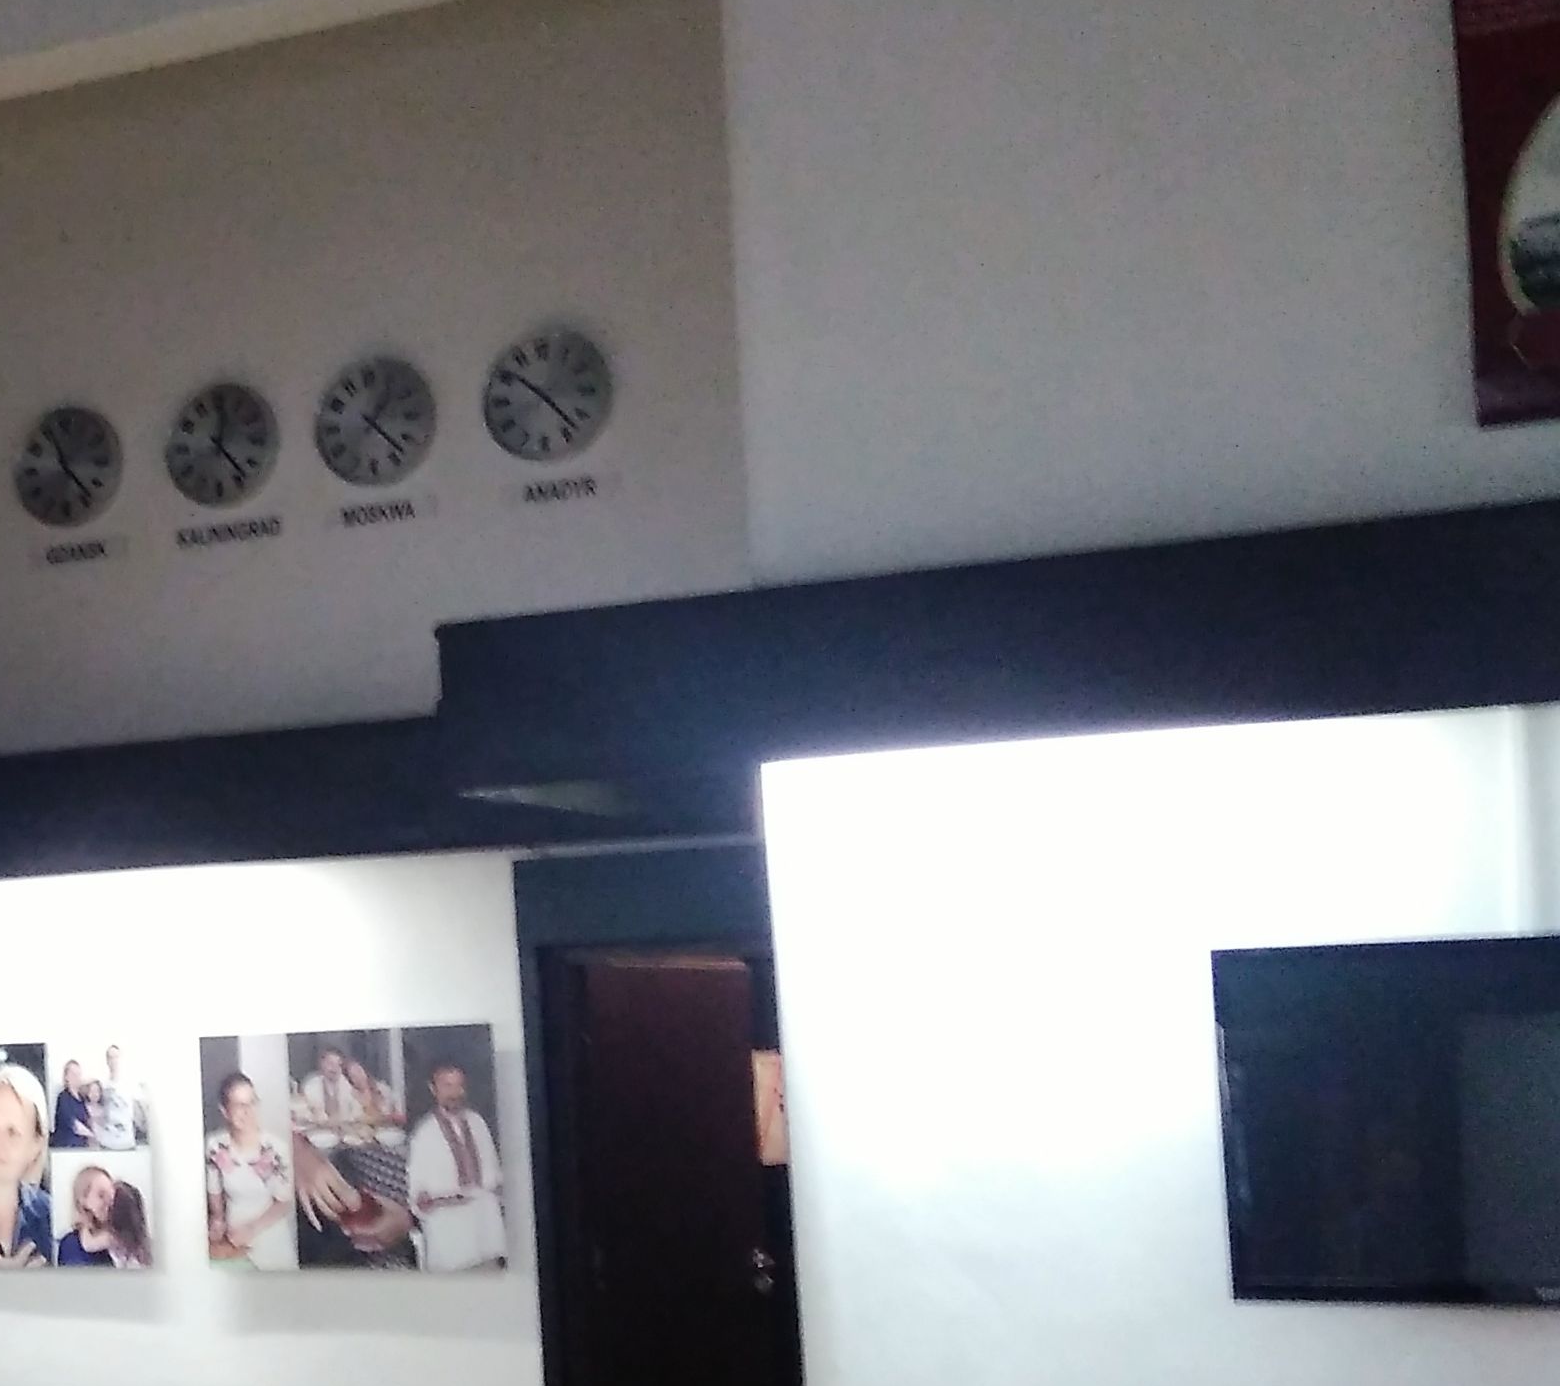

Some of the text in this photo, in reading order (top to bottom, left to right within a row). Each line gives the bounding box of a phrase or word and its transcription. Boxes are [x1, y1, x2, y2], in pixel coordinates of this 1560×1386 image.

[523, 475, 598, 502] ANADYR
[340, 502, 416, 528] MOSKWA
[176, 516, 283, 550] KALININGRAD
